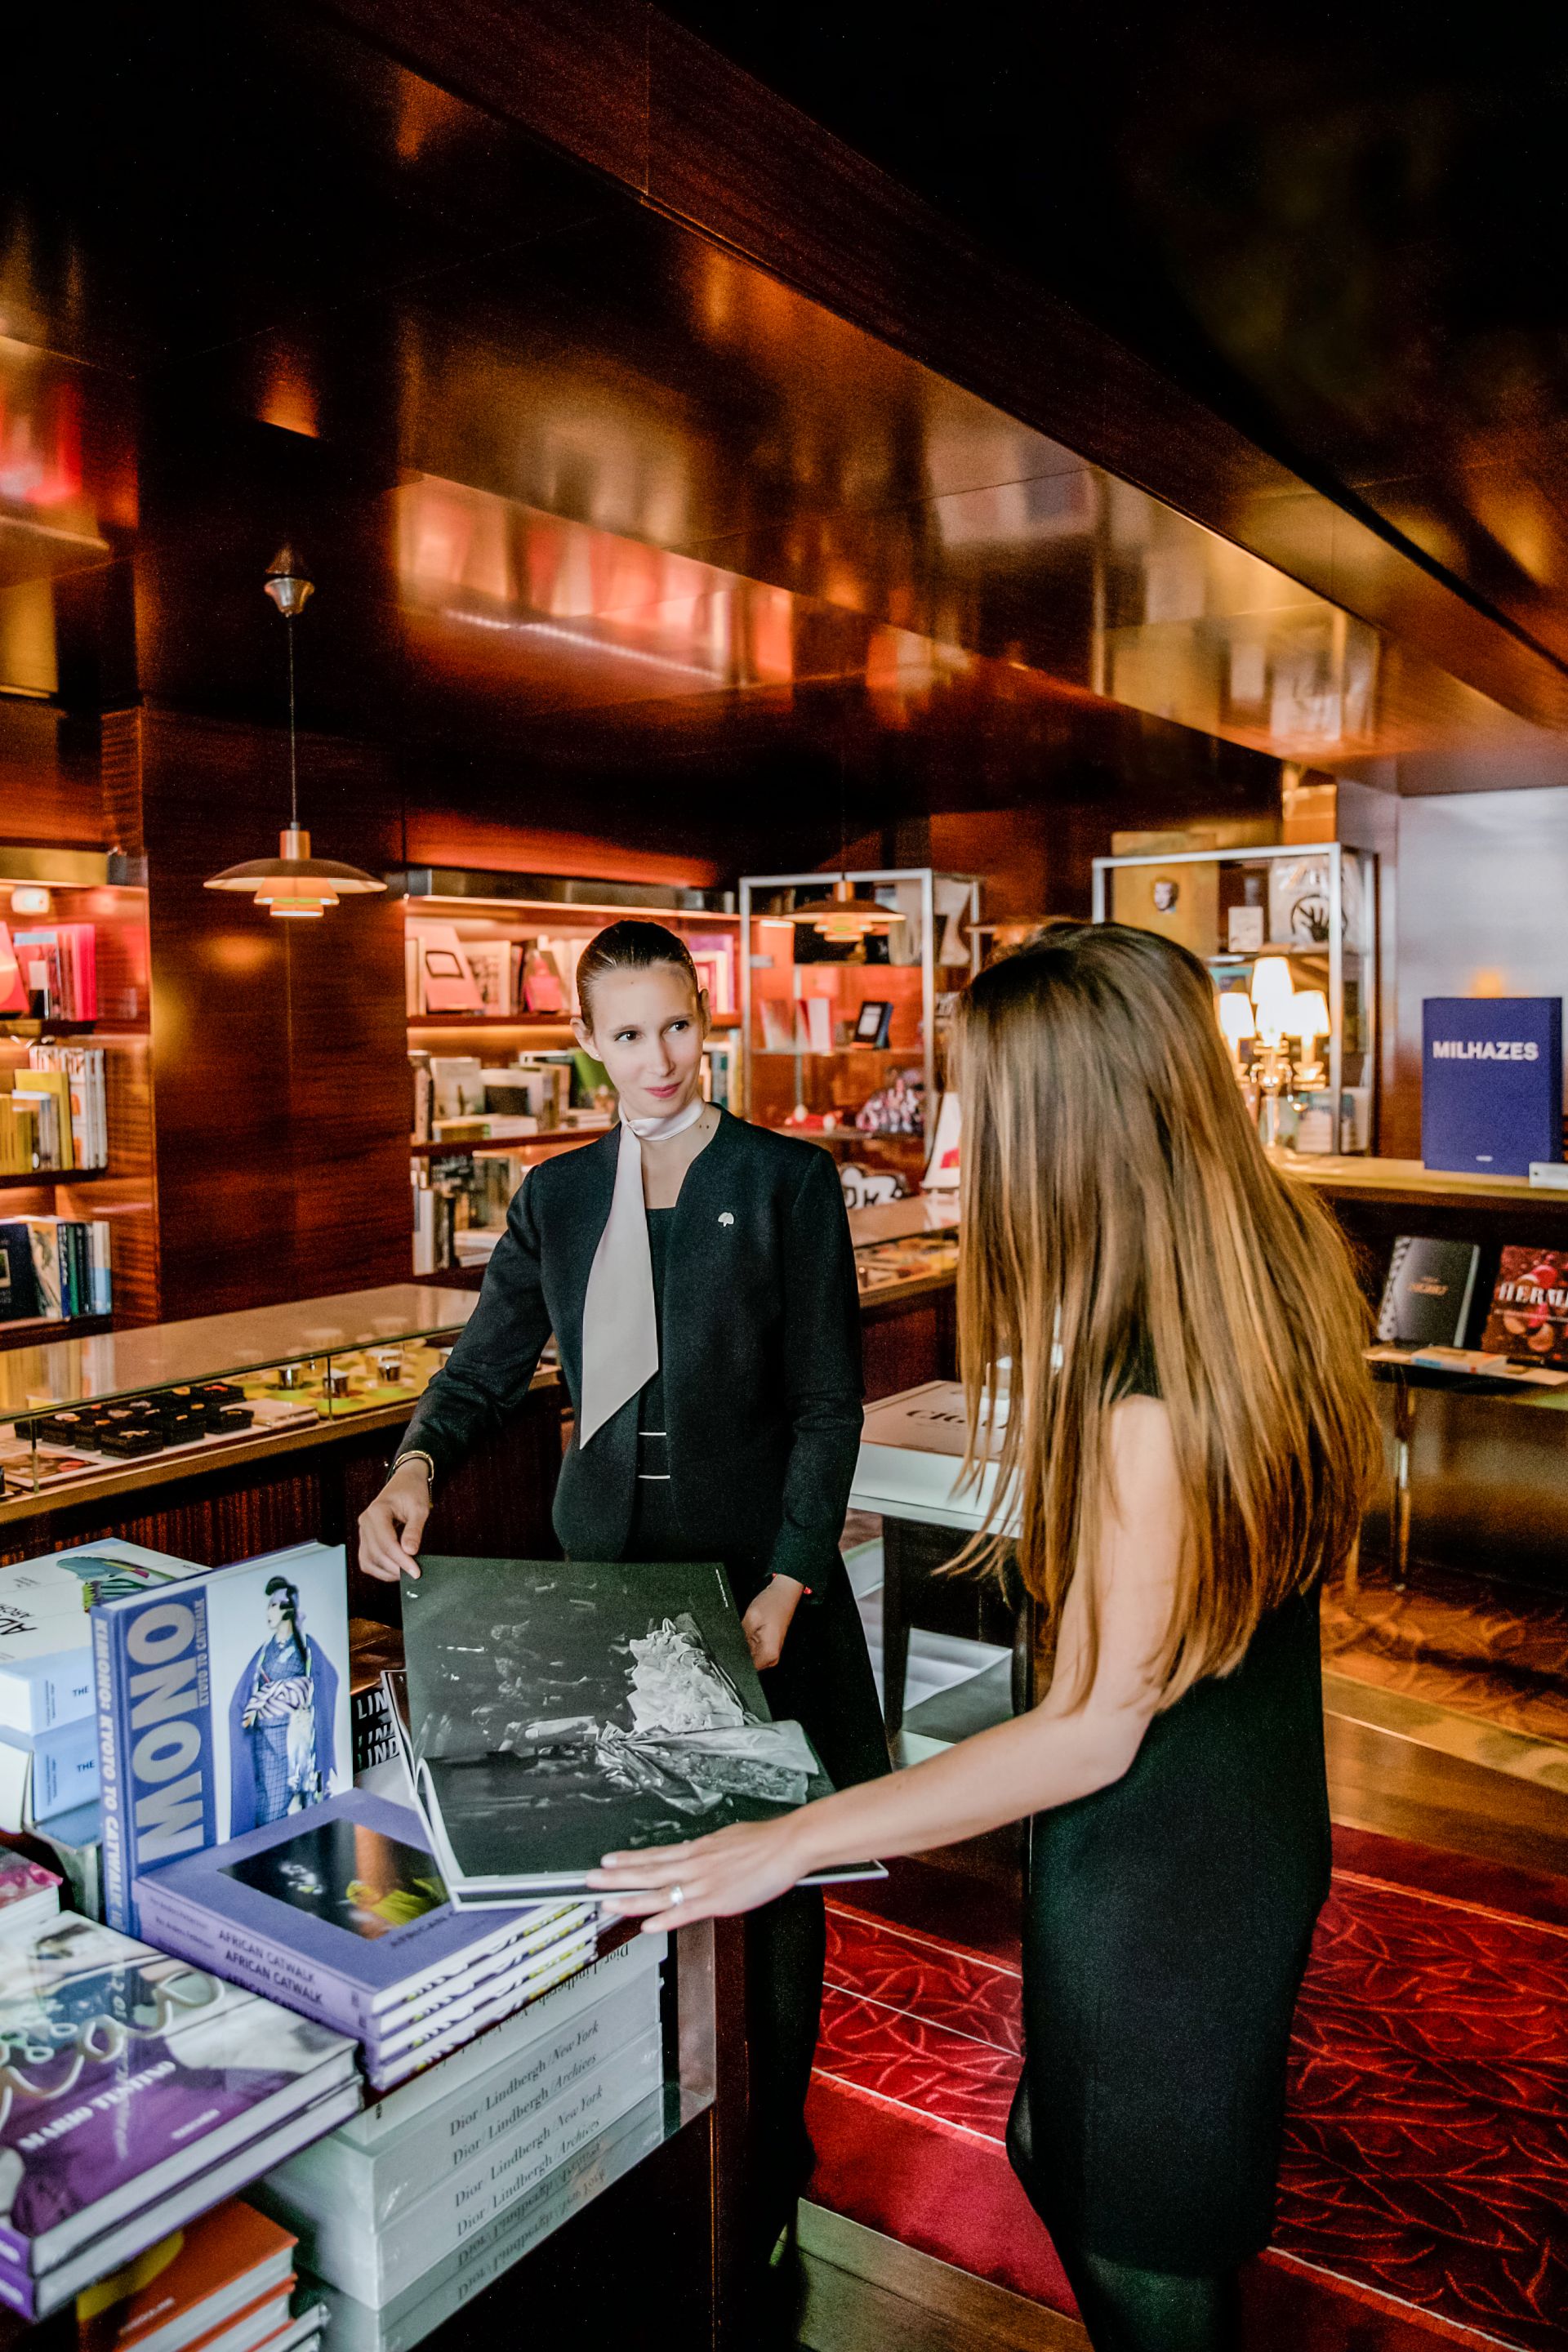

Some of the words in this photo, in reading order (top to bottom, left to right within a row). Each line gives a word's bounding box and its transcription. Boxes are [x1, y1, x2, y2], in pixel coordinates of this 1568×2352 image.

[1432, 1040, 1539, 1061] MILHAZES
[1499, 1281, 1568, 1307] HERM
[72, 1685, 90, 1697] THE
[94, 1618, 112, 1711] KIMONO:
[76, 1759, 96, 1773] THE
[100, 1713, 117, 1781] KYOTO
[104, 1785, 118, 1811] TO
[105, 1815, 123, 1909] CATWALK
[218, 1929, 264, 1959] AFRICAN
[267, 1950, 315, 1983] CATWALK
[225, 1949, 272, 1981] AFRICAN
[274, 1970, 323, 2004] CATWALK
[604, 1944, 629, 1964] Dior
[449, 2107, 479, 2136] Dior
[485, 2059, 546, 2111] Lindbergh
[575, 2020, 599, 2047] York
[452, 2137, 482, 2166] Dior
[488, 2087, 550, 2140] Lindbergh
[554, 2052, 597, 2092] Archives
[454, 2179, 483, 2207] Dior
[491, 2126, 551, 2180] Lindbergh
[581, 2083, 604, 2112] York
[457, 2207, 486, 2237] Dior
[492, 2154, 553, 2208] Lindbergh
[559, 2118, 601, 2154] Archives
